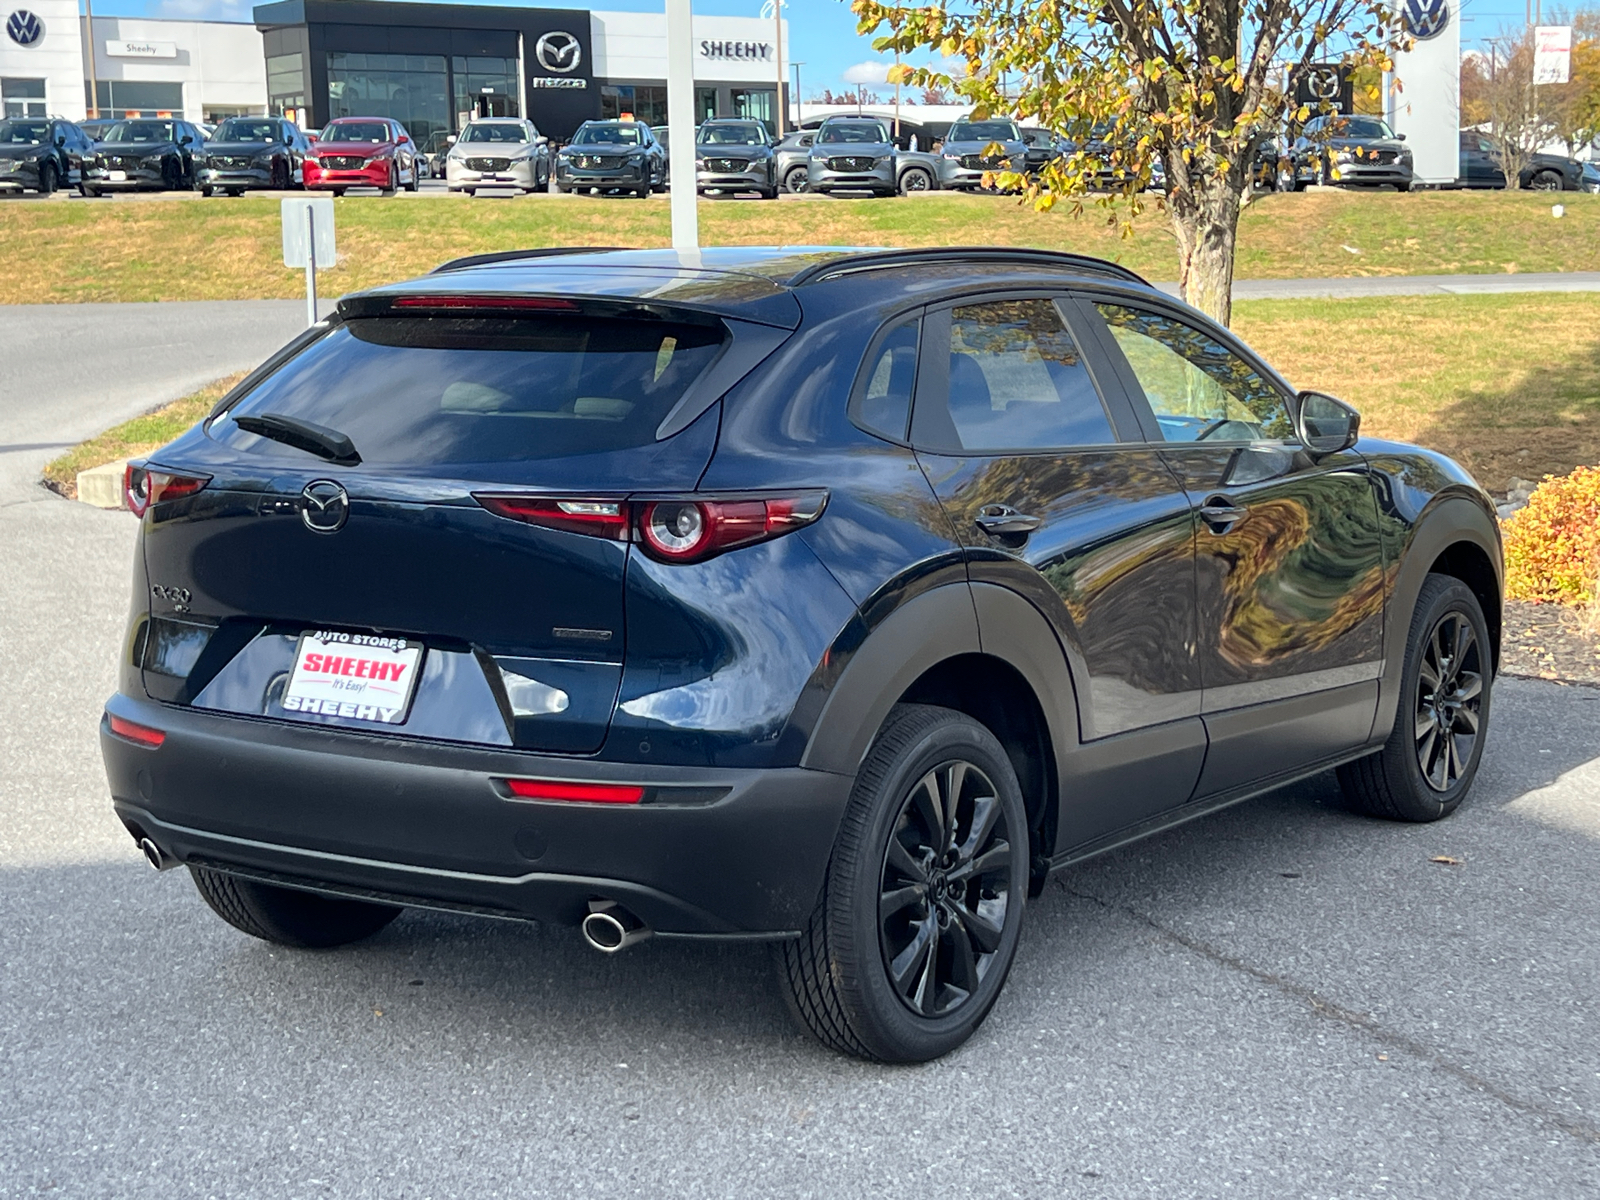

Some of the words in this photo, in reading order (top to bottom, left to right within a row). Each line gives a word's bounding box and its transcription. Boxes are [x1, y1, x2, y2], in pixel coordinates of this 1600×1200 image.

[126, 43, 157, 55] Sheehy
[700, 40, 768, 58] SHEEHY
[313, 630, 350, 643] AUTO
[302, 652, 407, 682] SHEEHY
[332, 678, 344, 690] It's
[345, 680, 368, 694] Easy!
[283, 696, 401, 723] SHEEHY
